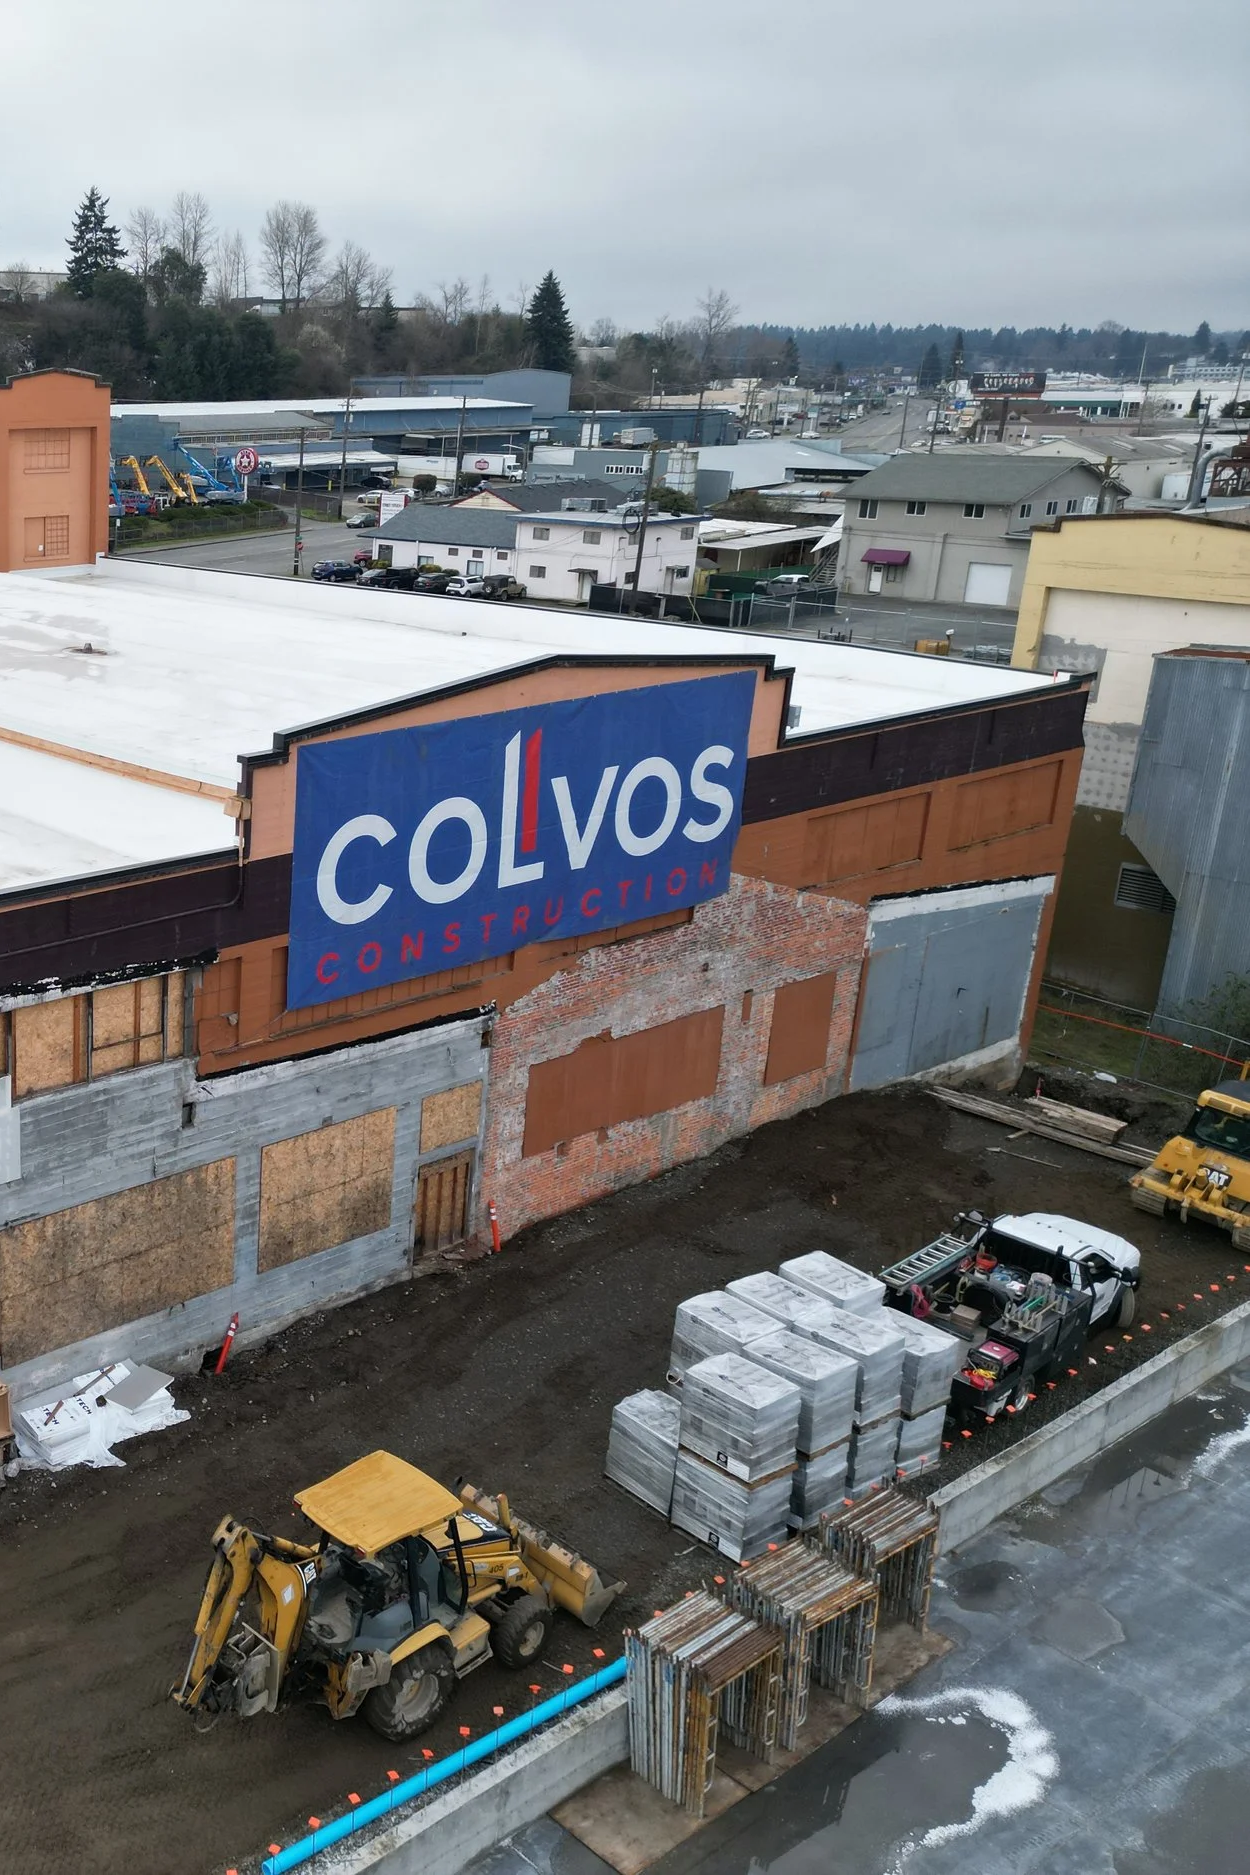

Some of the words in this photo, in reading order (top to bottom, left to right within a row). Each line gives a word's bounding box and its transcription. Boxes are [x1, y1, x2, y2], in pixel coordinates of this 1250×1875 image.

[316, 728, 735, 925] COLVOS
[316, 859, 718, 984] CONSTRUCTION
[42, 1407, 60, 1425] TEH
